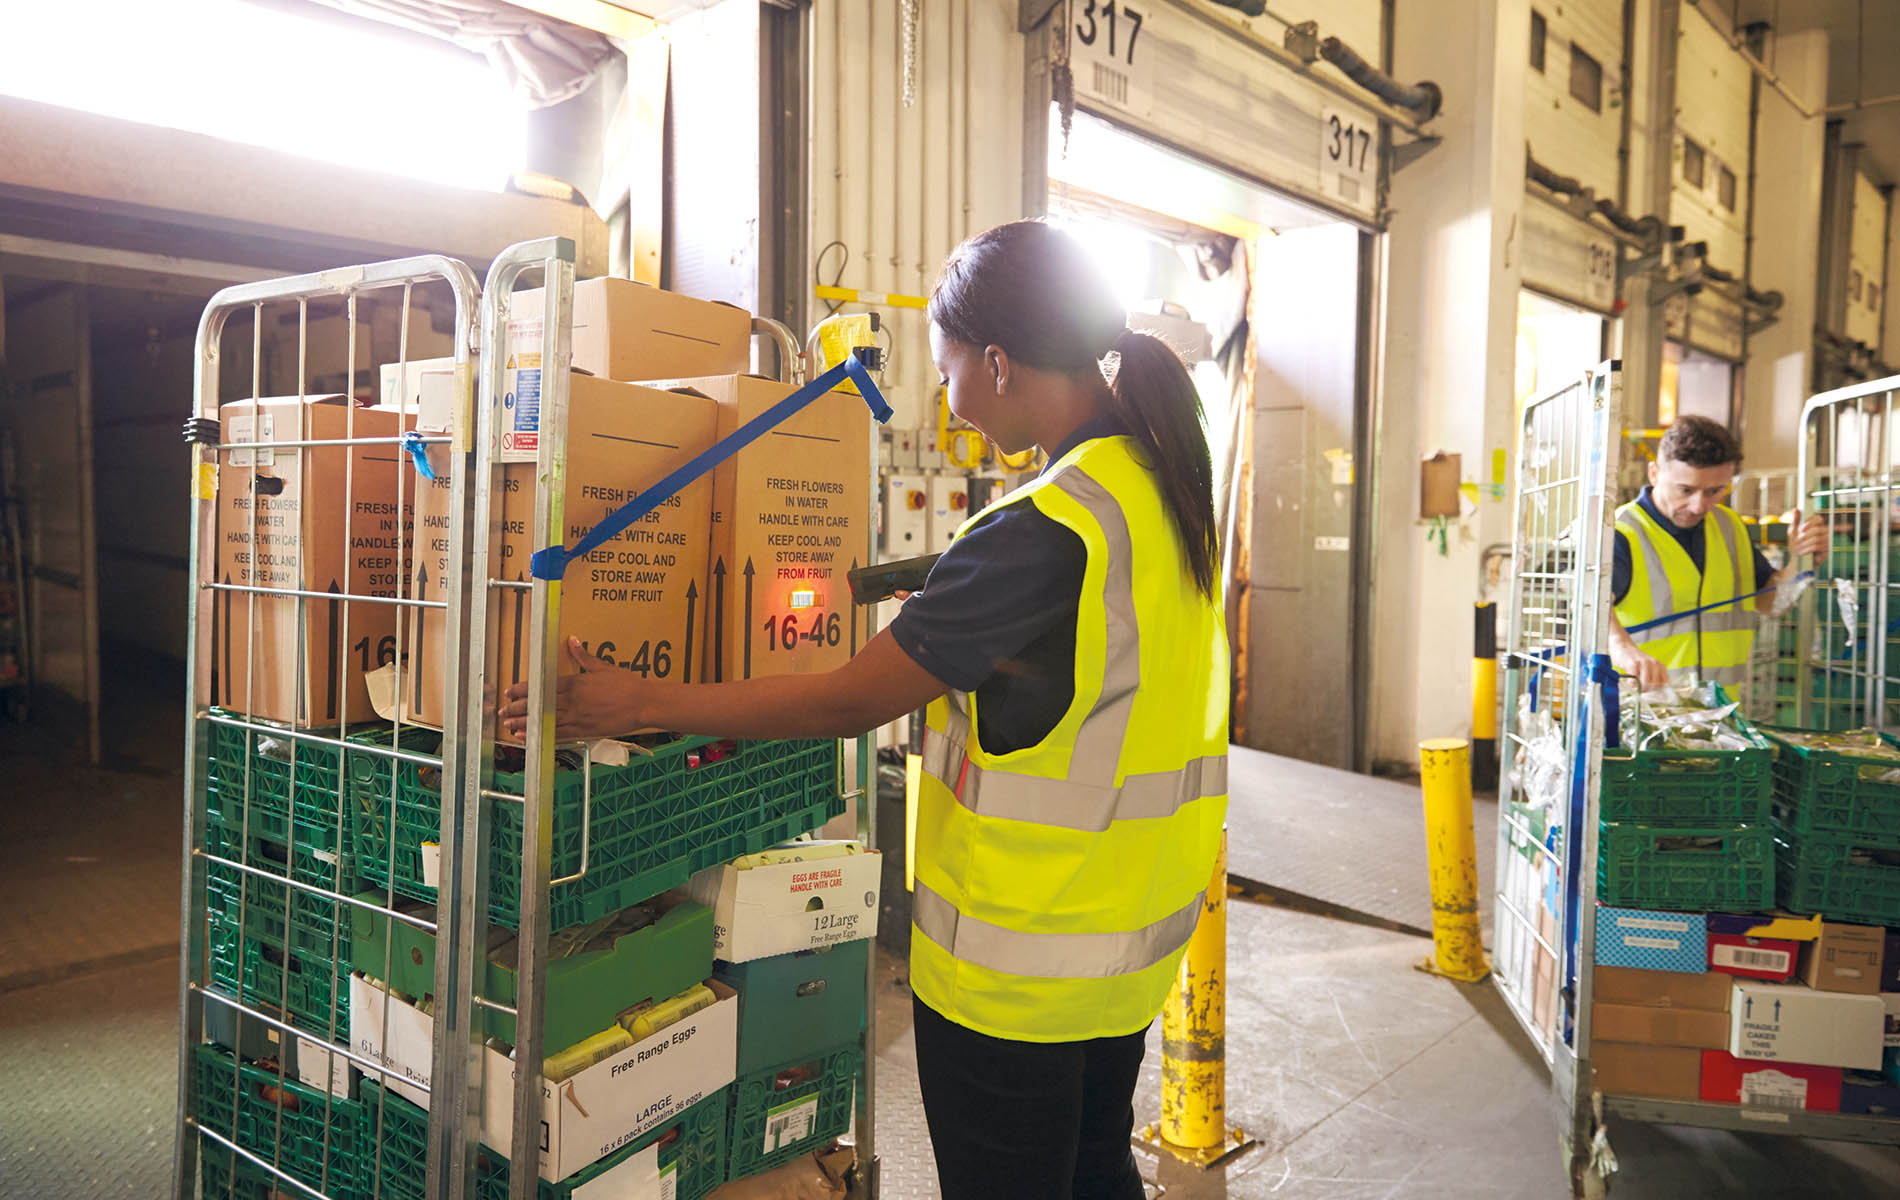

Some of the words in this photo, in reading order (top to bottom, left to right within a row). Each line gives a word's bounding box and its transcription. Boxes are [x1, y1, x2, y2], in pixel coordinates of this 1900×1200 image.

[1076, 0, 1142, 66] 317
[1328, 114, 1371, 174] 317
[767, 477, 799, 491] FRESH
[801, 480, 844, 494] FLOWERS
[582, 485, 623, 502] FRESH
[232, 497, 259, 510] FREH
[261, 499, 298, 511] FLOWERS
[355, 503, 398, 515] FRESH
[785, 496, 794, 507] IN
[797, 497, 828, 509] WATER
[380, 519, 392, 530] IN
[759, 513, 799, 526] HANDLE
[802, 515, 824, 527] WITH
[826, 516, 849, 528] CARE
[227, 533, 259, 545] HANDE
[262, 534, 280, 545] WITH
[625, 529, 654, 543] WITH
[657, 532, 687, 545] CARE
[768, 534, 794, 546] KEEP
[796, 535, 822, 547] COOL
[823, 536, 842, 547] AND
[234, 552, 251, 564] KEE
[257, 554, 279, 566] COOL
[281, 556, 297, 567] AND
[358, 558, 392, 569] KEEP
[581, 550, 614, 563] KEEP
[618, 552, 649, 566] COOL
[653, 554, 676, 567] AND
[776, 551, 807, 563] STORE
[810, 552, 835, 563] AWAY
[269, 572, 290, 583] AWAY
[591, 569, 632, 583] STORE
[635, 571, 667, 584] AWAY
[777, 568, 805, 580] FROM
[807, 567, 833, 579] FRUIT
[592, 588, 627, 601] FROM
[631, 589, 664, 602] FRUIT
[763, 612, 841, 652] 16-46
[792, 873, 807, 883] EGGS
[808, 871, 819, 881] ARE
[820, 868, 842, 880] FRAGILE
[790, 881, 812, 893] HANDLE
[813, 880, 828, 889] WITH
[829, 878, 842, 888] CARE
[810, 935, 824, 944] Free
[824, 932, 842, 942] Range
[843, 929, 857, 939] Eggs
[611, 1059, 635, 1078] Free
[637, 1040, 670, 1064] Range
[672, 1025, 696, 1045] Eggs
[636, 1094, 673, 1123] LARGE
[600, 1144, 609, 1155] 16
[617, 1137, 622, 1146] 6
[624, 1125, 642, 1144] pack
[643, 1108, 674, 1130] contains
[675, 1101, 685, 1112] 96
[685, 1091, 702, 1106] eggs
